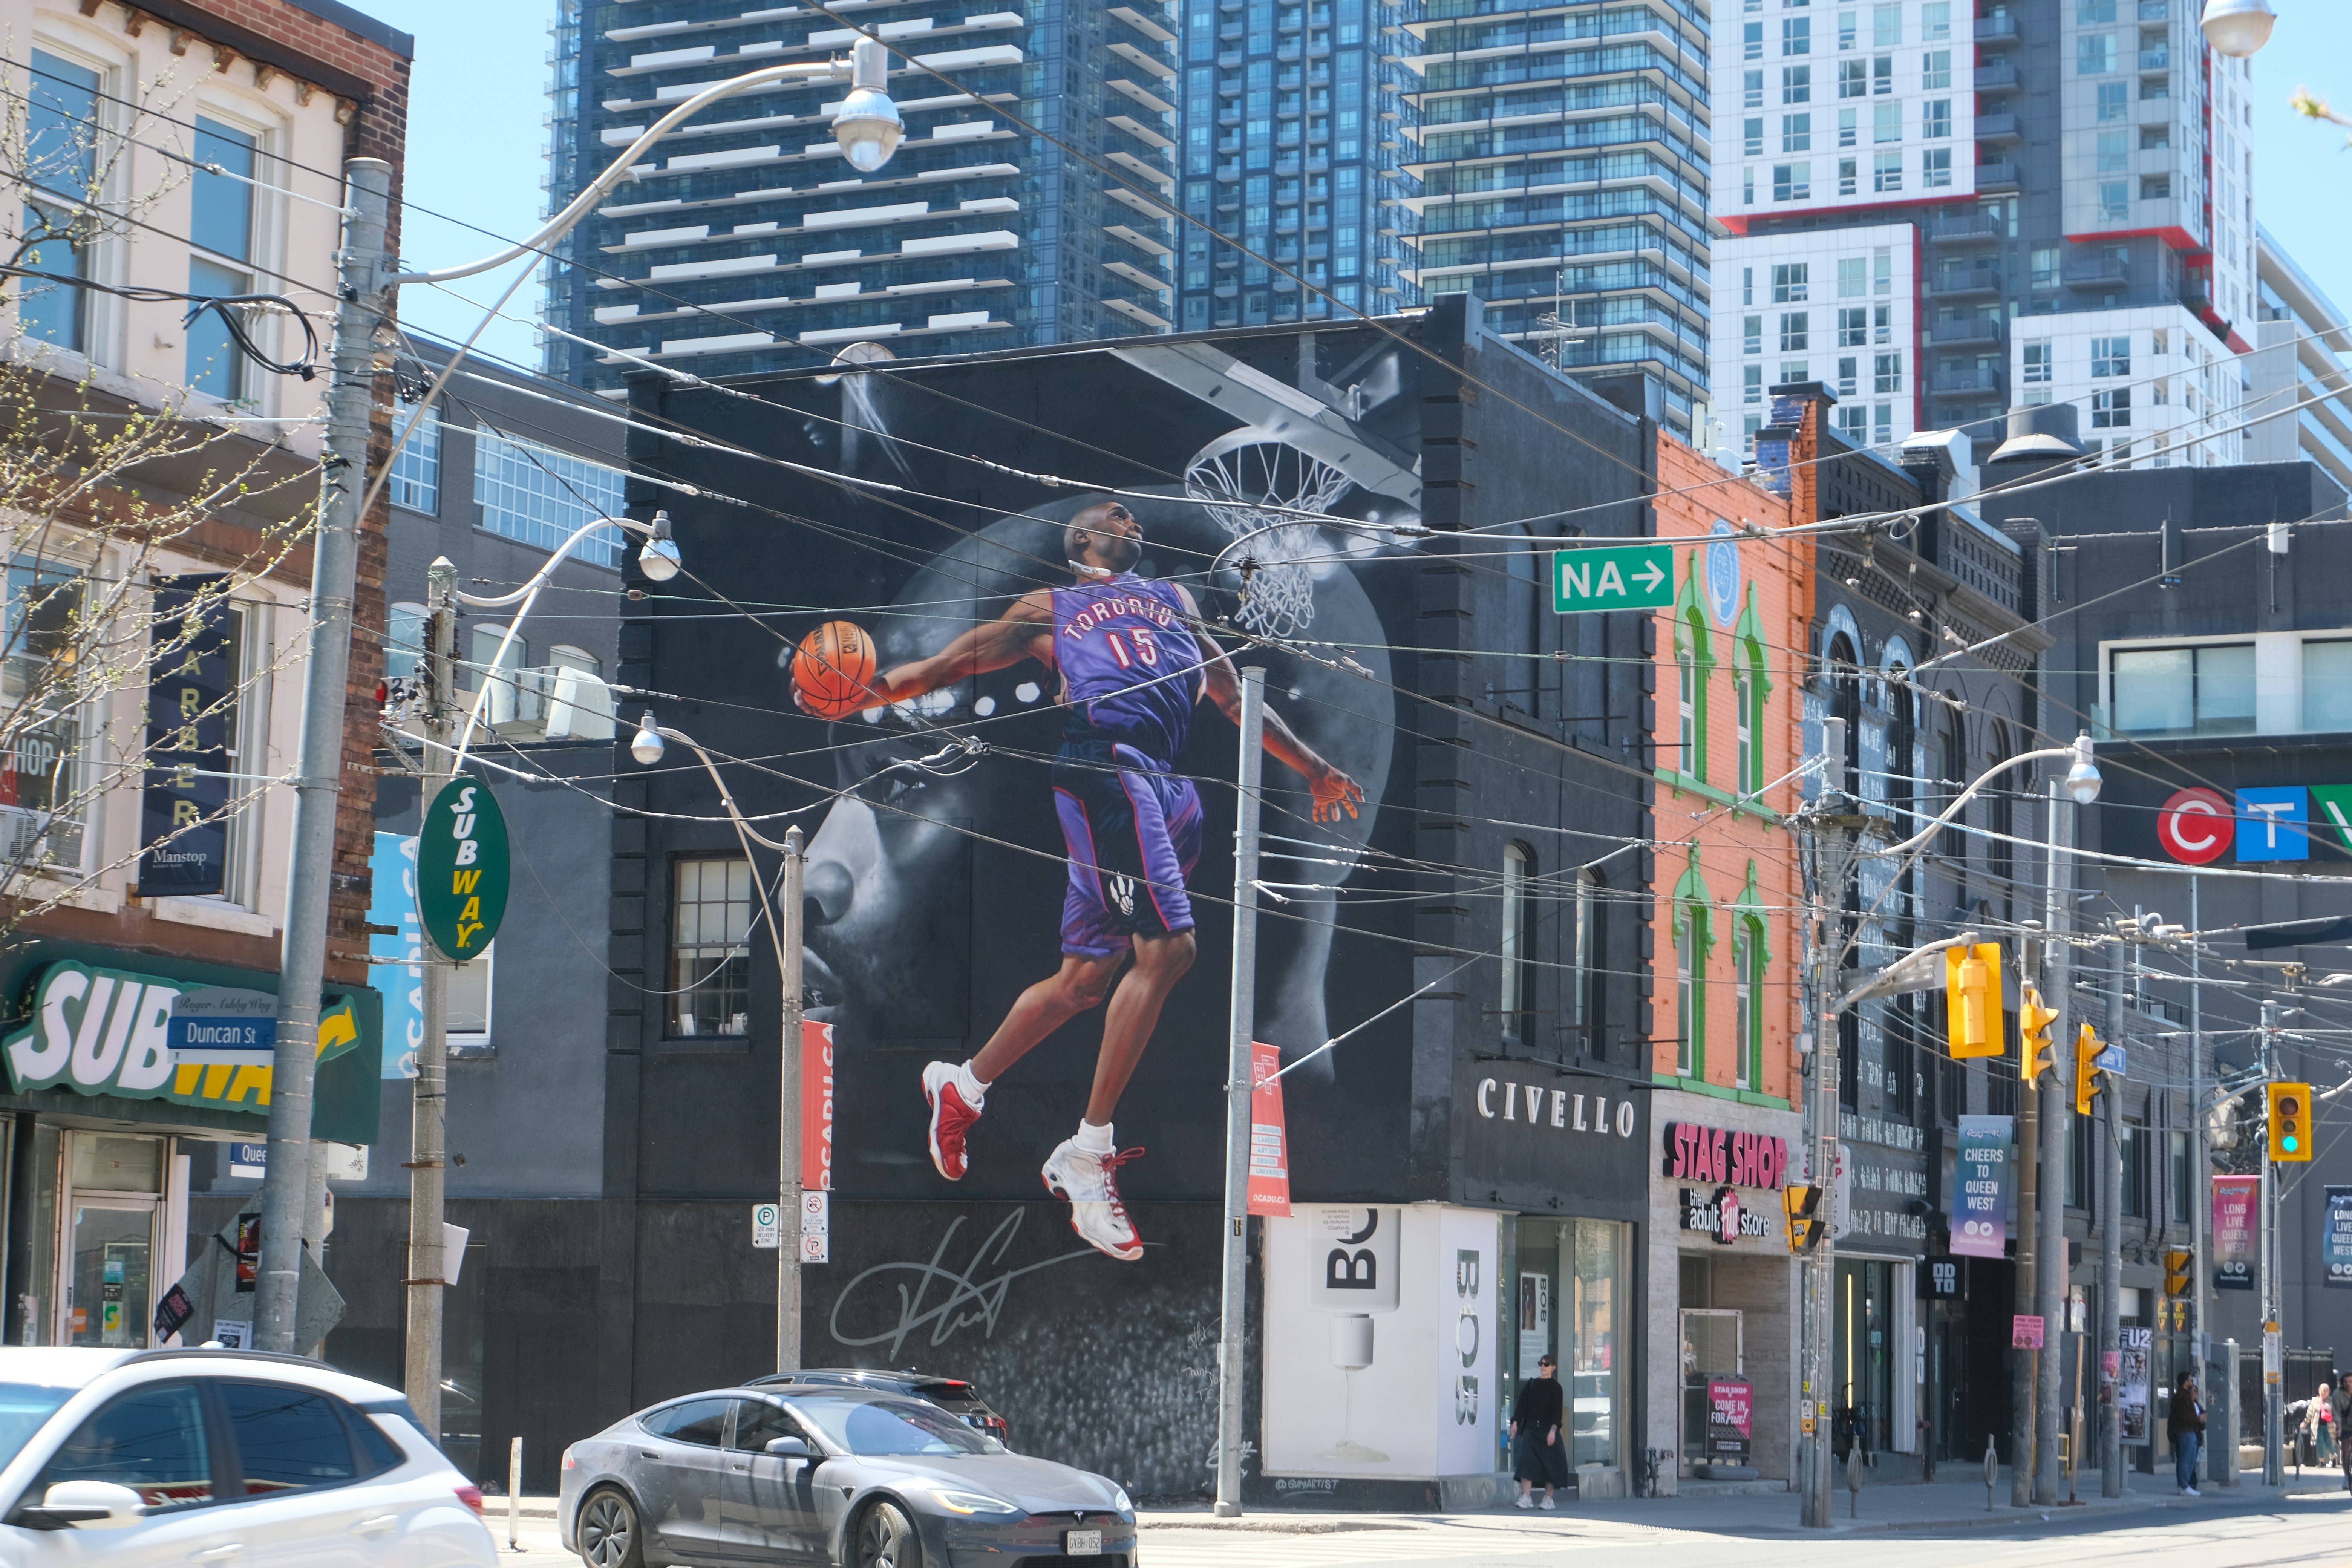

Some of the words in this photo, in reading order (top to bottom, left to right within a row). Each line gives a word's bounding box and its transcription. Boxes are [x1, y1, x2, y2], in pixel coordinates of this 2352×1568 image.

[1562, 560, 1627, 599] NA
[1063, 597, 1173, 641] TORONTO
[1105, 626, 1159, 670] 15
[173, 613, 201, 826] ARBER
[153, 849, 207, 866] Manstop
[450, 787, 484, 948] SUBWAY
[179, 997, 211, 1013] Roger
[249, 998, 271, 1013] Way
[187, 1022, 241, 1043] Duncan
[244, 1027, 257, 1043] St
[1477, 1078, 1634, 1138] CIVELLO
[1257, 1136, 1279, 1145] LARGEST
[1673, 1121, 1726, 1184] STAG
[1732, 1130, 1787, 1190] SHOP
[1965, 1148, 2004, 1163] CHEERS
[1256, 1168, 1286, 1176] UNIVERSITY
[1977, 1164, 1989, 1178] TO
[1965, 1180, 1998, 1195] QUEEN
[1253, 1193, 1286, 1204] OCADU.CA
[1690, 1188, 1702, 1206] the
[1967, 1195, 1995, 1211] WEST
[763, 1211, 770, 1221] P
[2224, 1203, 2246, 1214] LONG
[1690, 1204, 1720, 1233] adult
[1741, 1207, 1770, 1237] store
[2226, 1216, 2245, 1227] LIVE
[2222, 1229, 2248, 1240] QUEEN
[2332, 1233, 2352, 1243] QUEE
[2224, 1242, 2246, 1253] WEST
[1455, 1248, 1479, 1426] BOB
[2130, 1328, 2150, 1348] U2
[1715, 1399, 1736, 1411] COME
[1737, 1400, 1745, 1412] IN
[1711, 1412, 1725, 1423] FOR
[1725, 1407, 1749, 1425] Fun!
[1070, 1537, 1085, 1549] GVBH
[1089, 1537, 1100, 1549] 052
